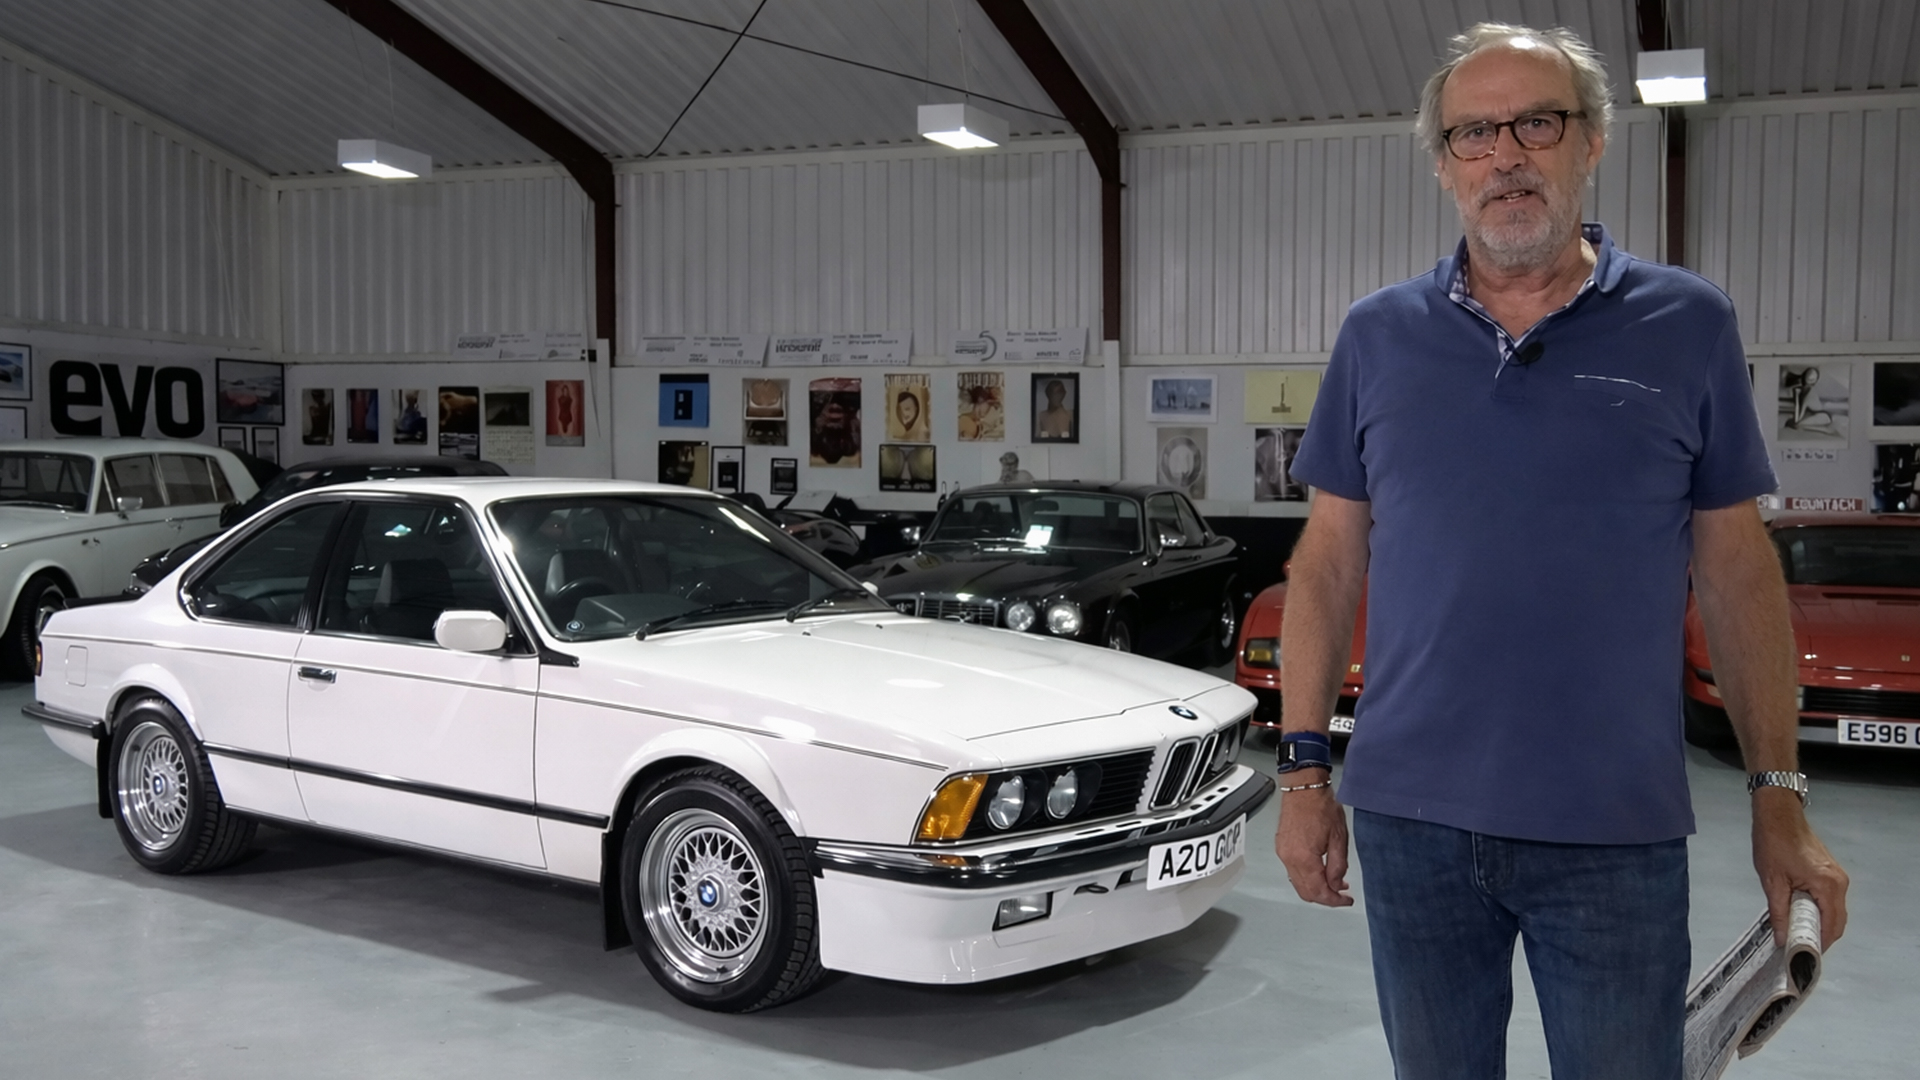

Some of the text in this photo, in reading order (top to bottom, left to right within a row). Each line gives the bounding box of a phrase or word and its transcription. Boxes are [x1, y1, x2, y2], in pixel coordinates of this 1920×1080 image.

[49, 360, 205, 439] evo
[1848, 722, 1907, 744] E596
[1159, 840, 1210, 881] A20
